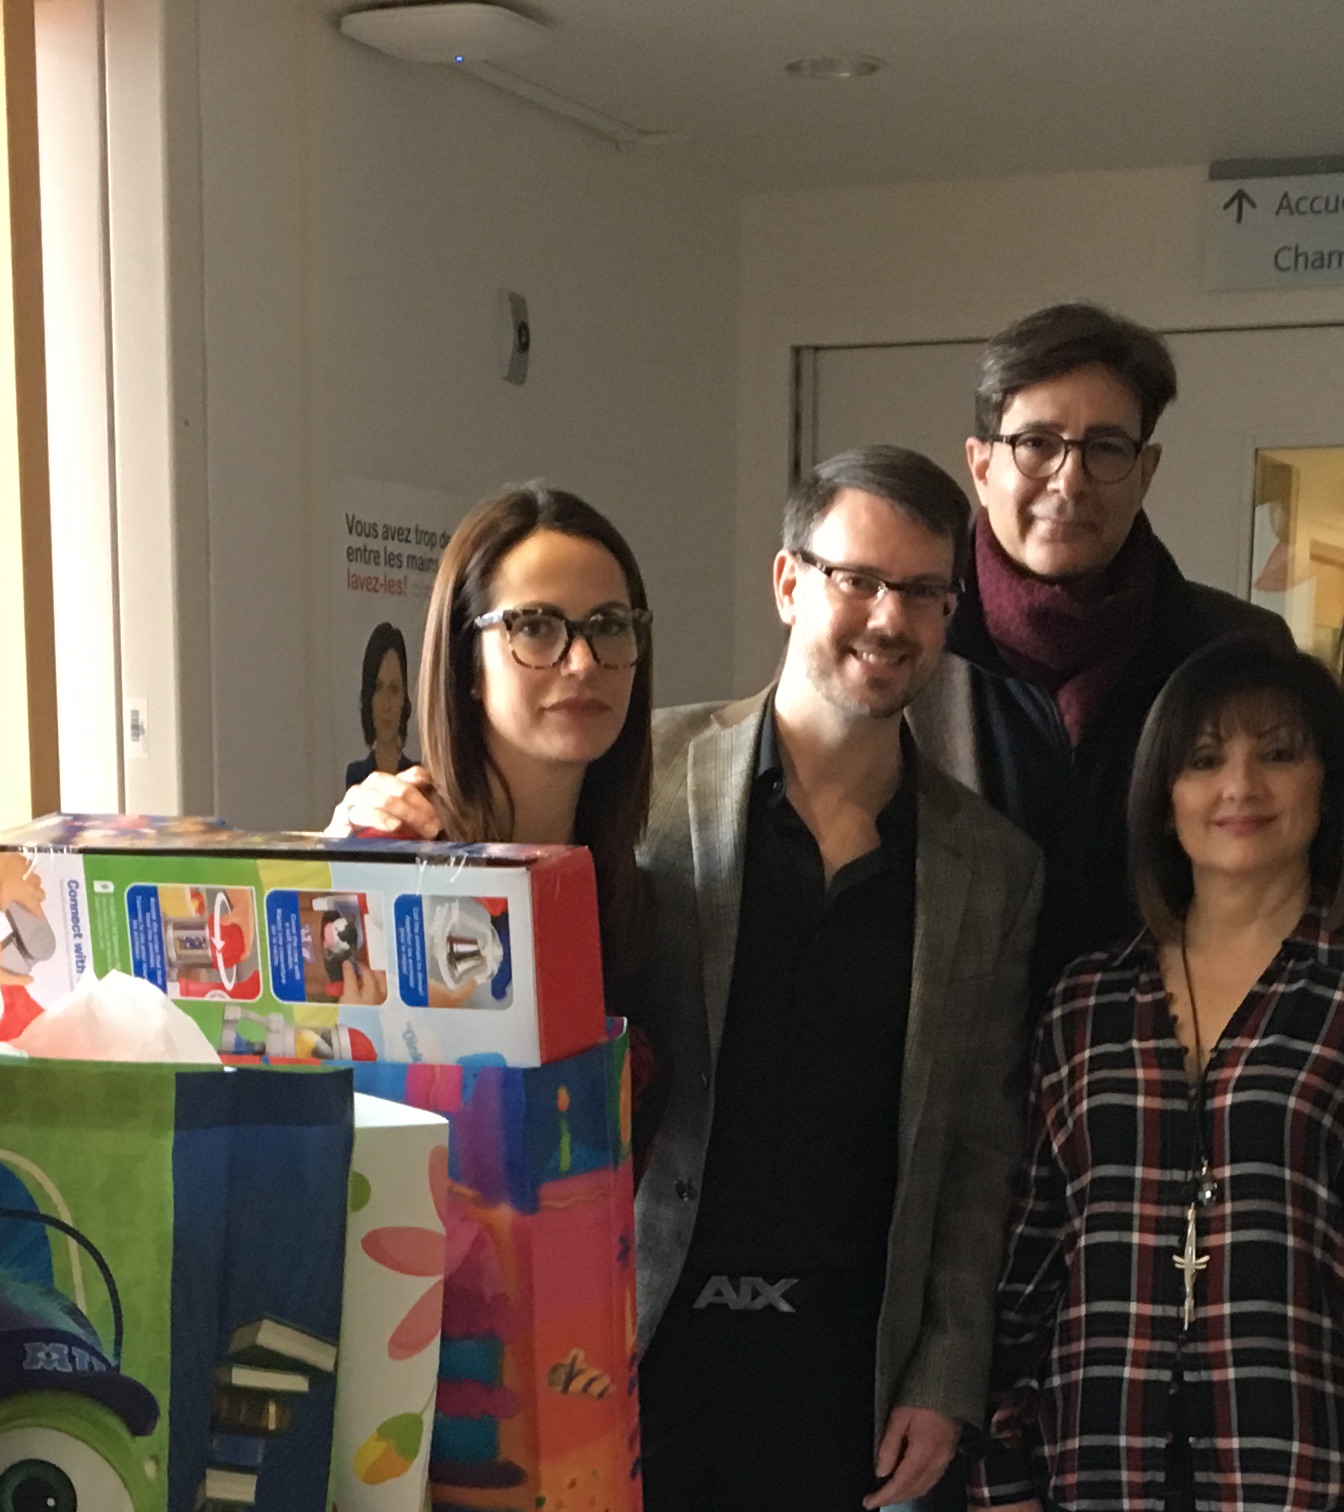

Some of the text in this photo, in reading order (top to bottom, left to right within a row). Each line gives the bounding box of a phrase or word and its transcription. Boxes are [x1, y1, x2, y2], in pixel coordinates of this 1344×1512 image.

[345, 512, 379, 539] Vous
[382, 523, 412, 543] avez
[415, 524, 437, 551] trop
[346, 543, 380, 566] entre
[384, 546, 403, 569] les
[347, 567, 407, 595] lavez-les!
[67, 880, 83, 939] Connect
[74, 943, 86, 973] with
